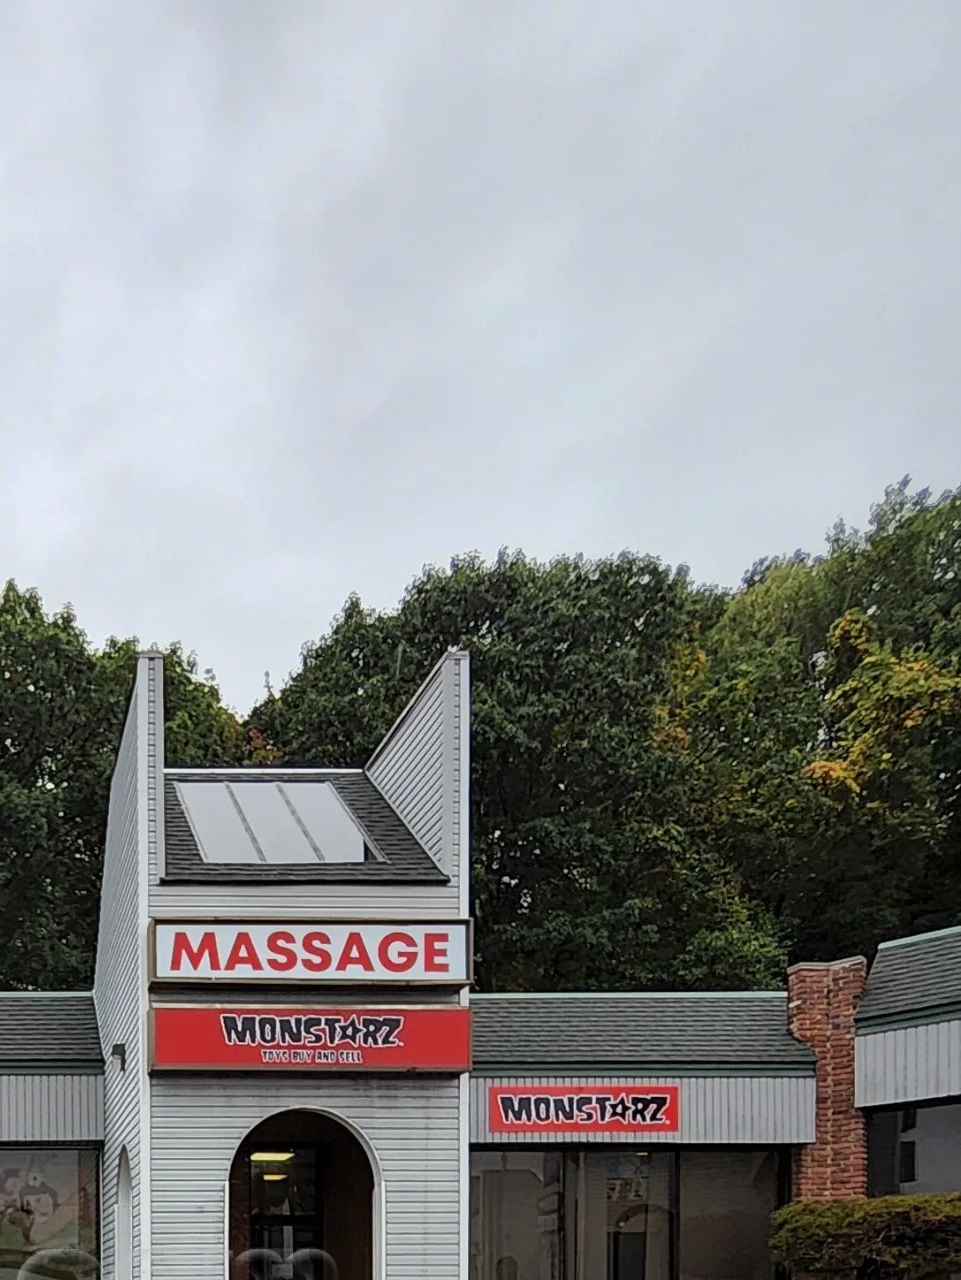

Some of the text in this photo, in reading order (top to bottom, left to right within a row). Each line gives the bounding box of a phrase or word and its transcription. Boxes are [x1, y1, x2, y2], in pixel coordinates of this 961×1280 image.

[169, 931, 450, 973] MASSAGE
[261, 1049, 363, 1063] TOYS BUY AND SELL
